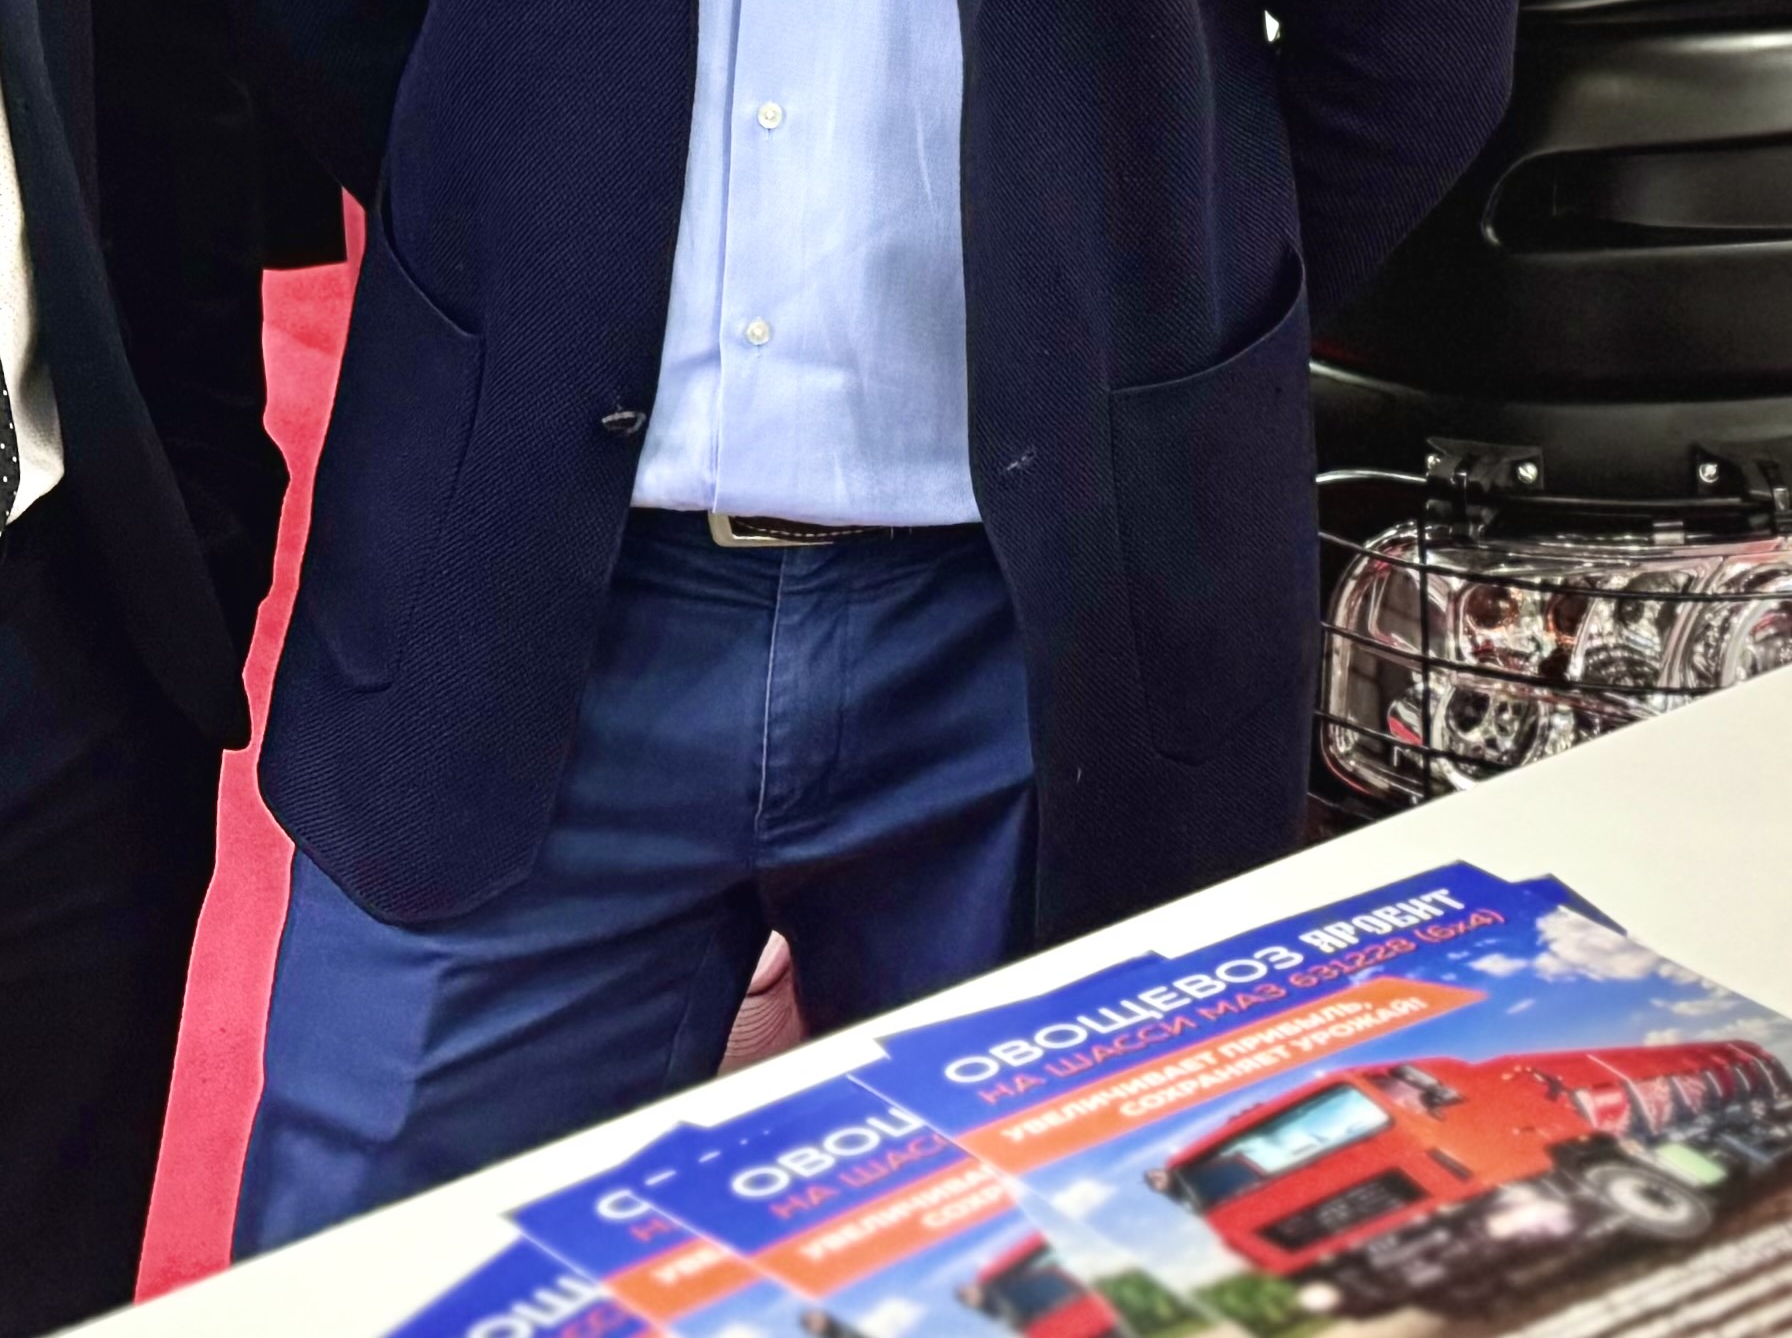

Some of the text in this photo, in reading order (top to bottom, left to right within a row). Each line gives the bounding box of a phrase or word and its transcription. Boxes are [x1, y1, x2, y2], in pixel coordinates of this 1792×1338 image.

[943, 944, 1304, 1084] ОВОЩЕВОЗ
[977, 1072, 1046, 1106] НА
[1045, 1017, 1197, 1079] ШАССИ
[1196, 980, 1288, 1023] МАЗ
